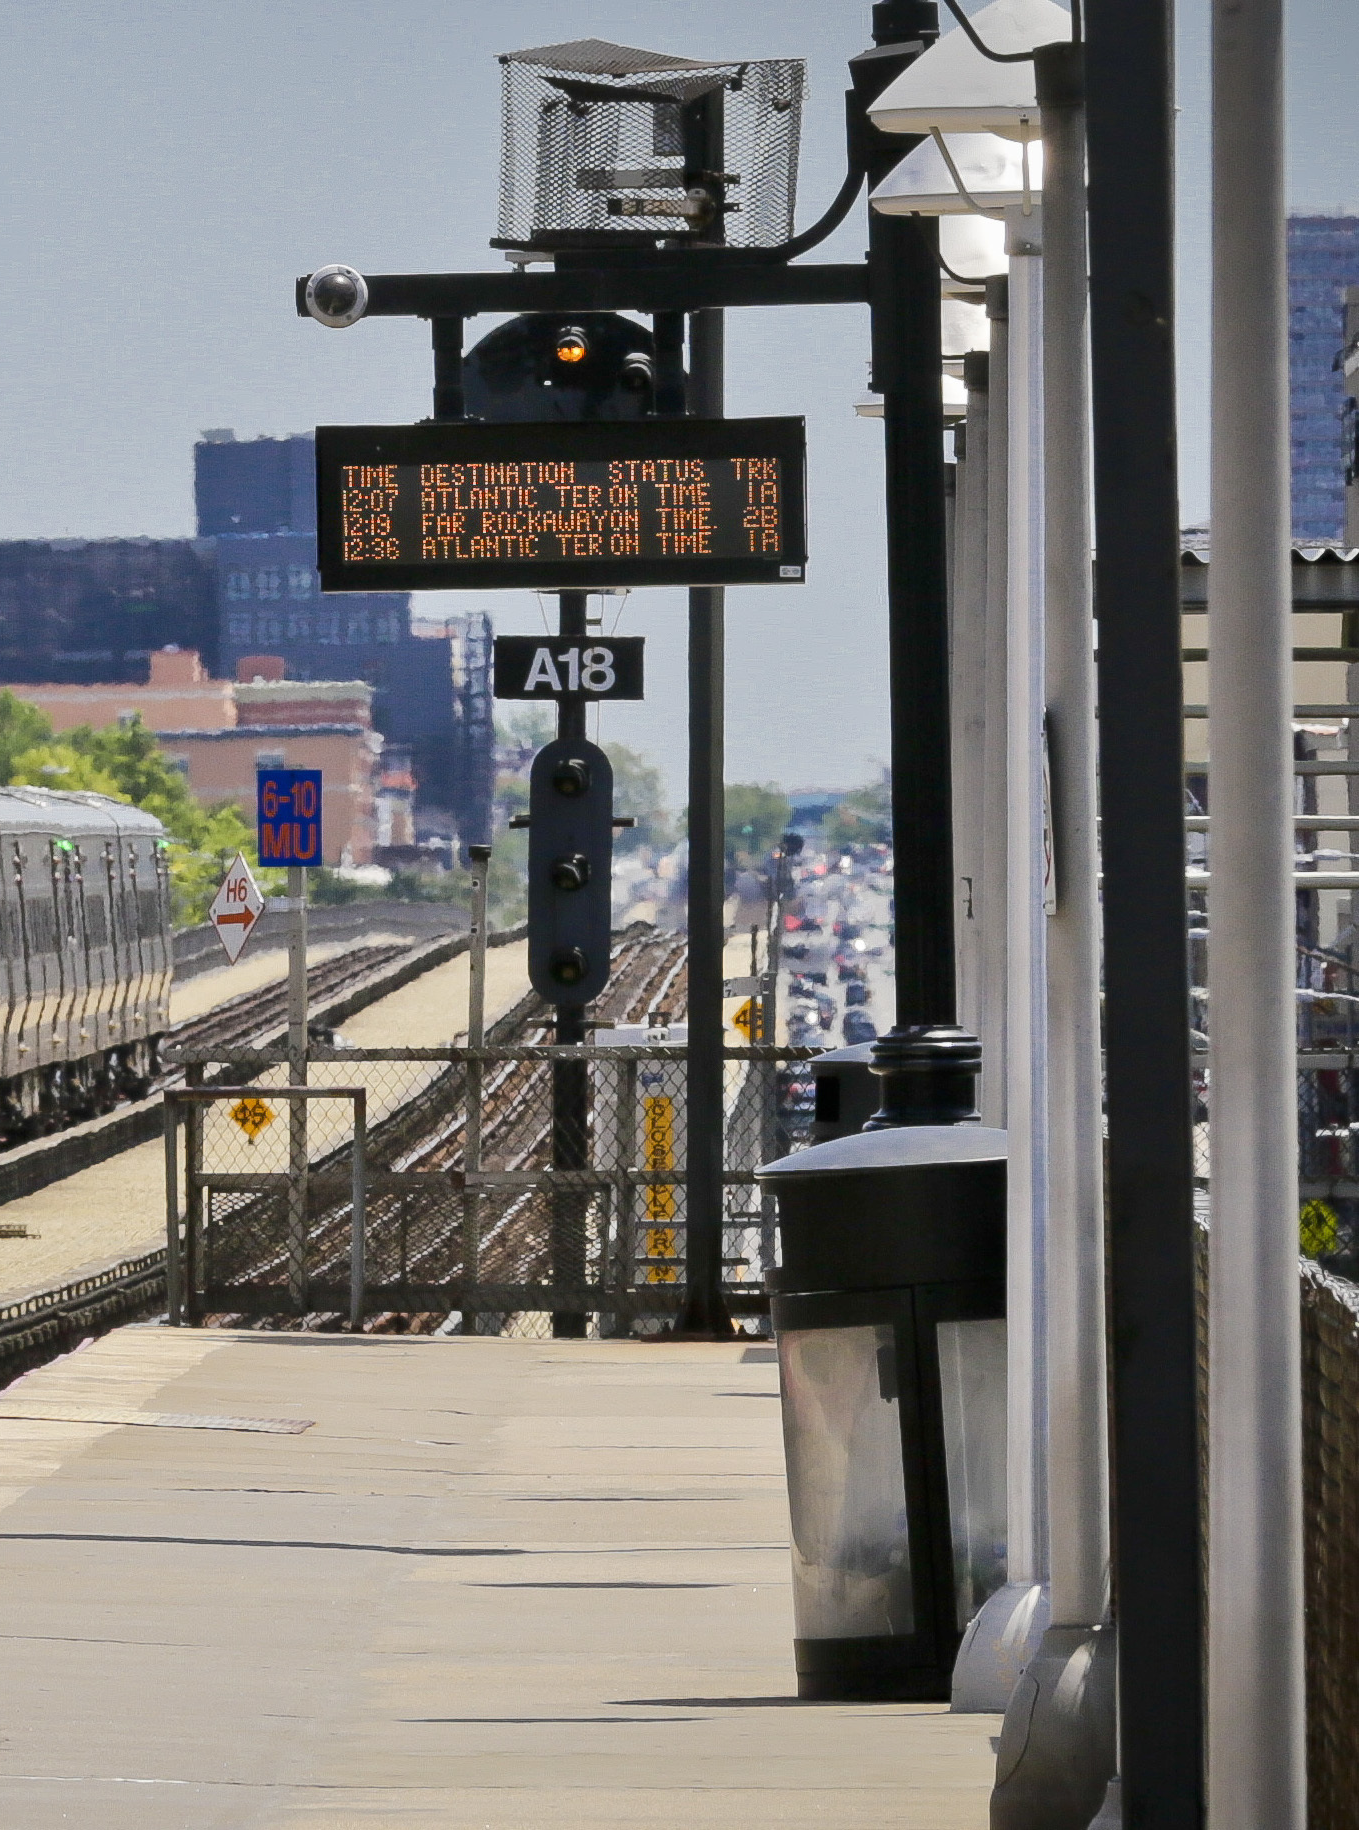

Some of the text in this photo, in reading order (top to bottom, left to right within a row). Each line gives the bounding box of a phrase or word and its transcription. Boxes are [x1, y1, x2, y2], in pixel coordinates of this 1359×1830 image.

[343, 457, 777, 487] TIME DESTINATION STATUS TRK
[342, 481, 778, 511] 12:07 ATLANTIC TER ON TIME 1A
[343, 513, 391, 537] 12:19
[421, 512, 467, 535] FAR
[482, 509, 609, 534] ROCKAWAY
[610, 508, 640, 532] ON
[743, 505, 778, 528] 2B
[344, 529, 780, 561] 12:36 ATLANTIC TER ON TIME 1A
[523, 646, 616, 692] A18
[263, 780, 317, 818] 6-10
[262, 823, 317, 860] MU
[226, 877, 248, 903] H6
